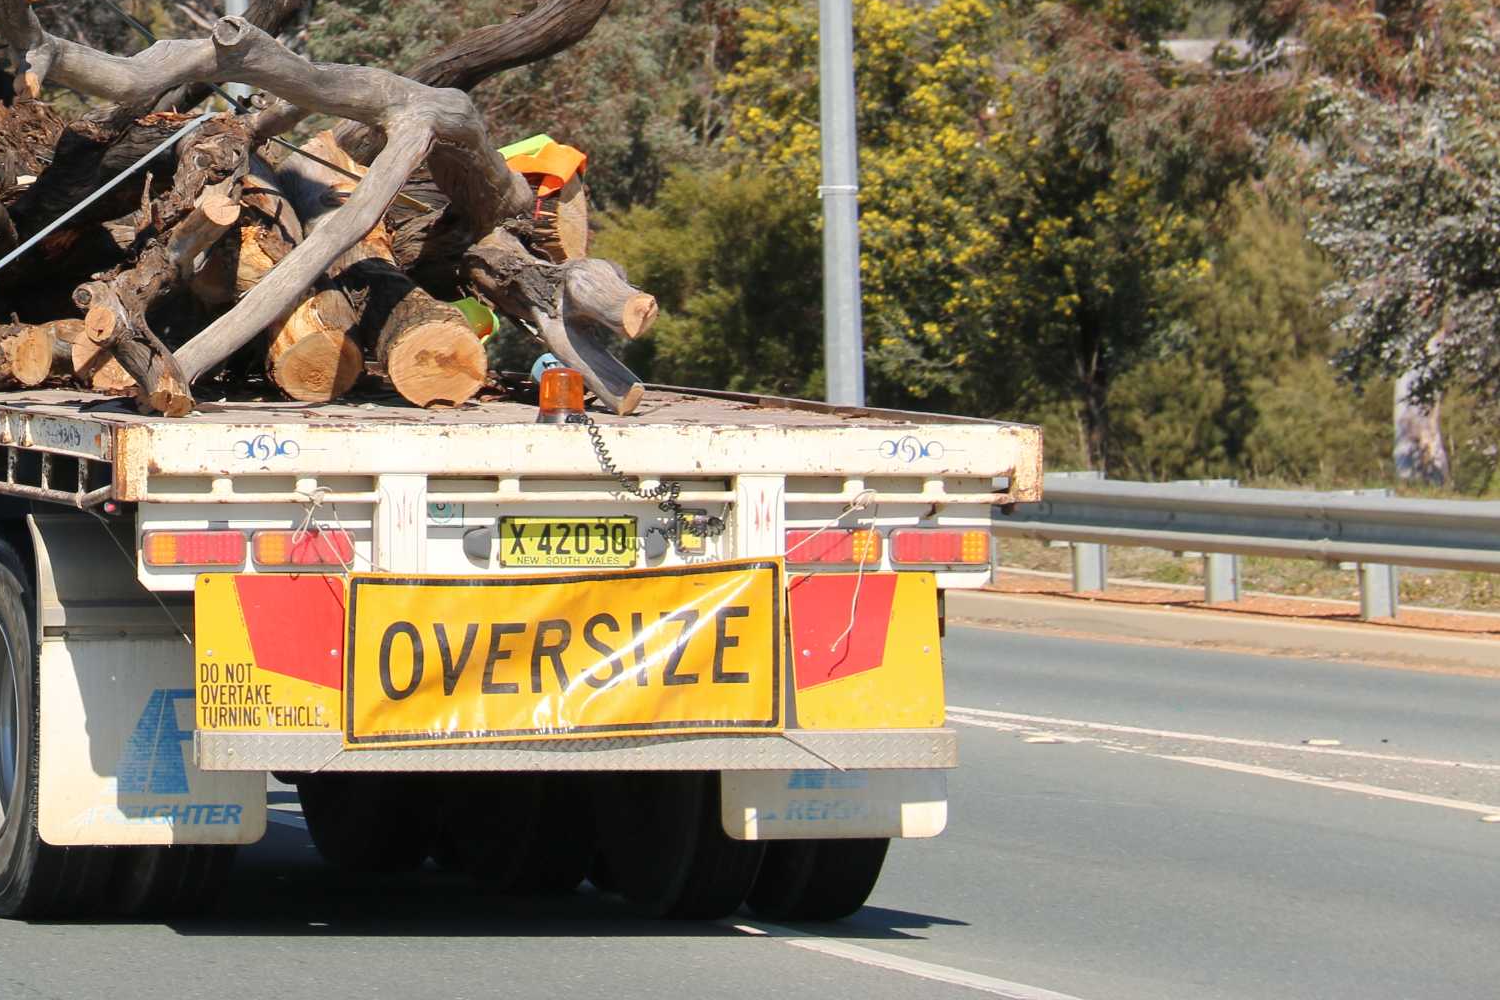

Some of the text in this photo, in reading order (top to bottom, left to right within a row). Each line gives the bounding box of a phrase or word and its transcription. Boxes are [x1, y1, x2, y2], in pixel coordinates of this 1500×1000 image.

[517, 556, 620, 565] NEW SOUTH WALES
[379, 606, 750, 700] OVERSIZE
[200, 663, 253, 683] DO NOT
[200, 685, 272, 705] OVERTAKE
[201, 706, 330, 728] TURNING VEHICLE
[86, 804, 243, 825] EIGHTER
